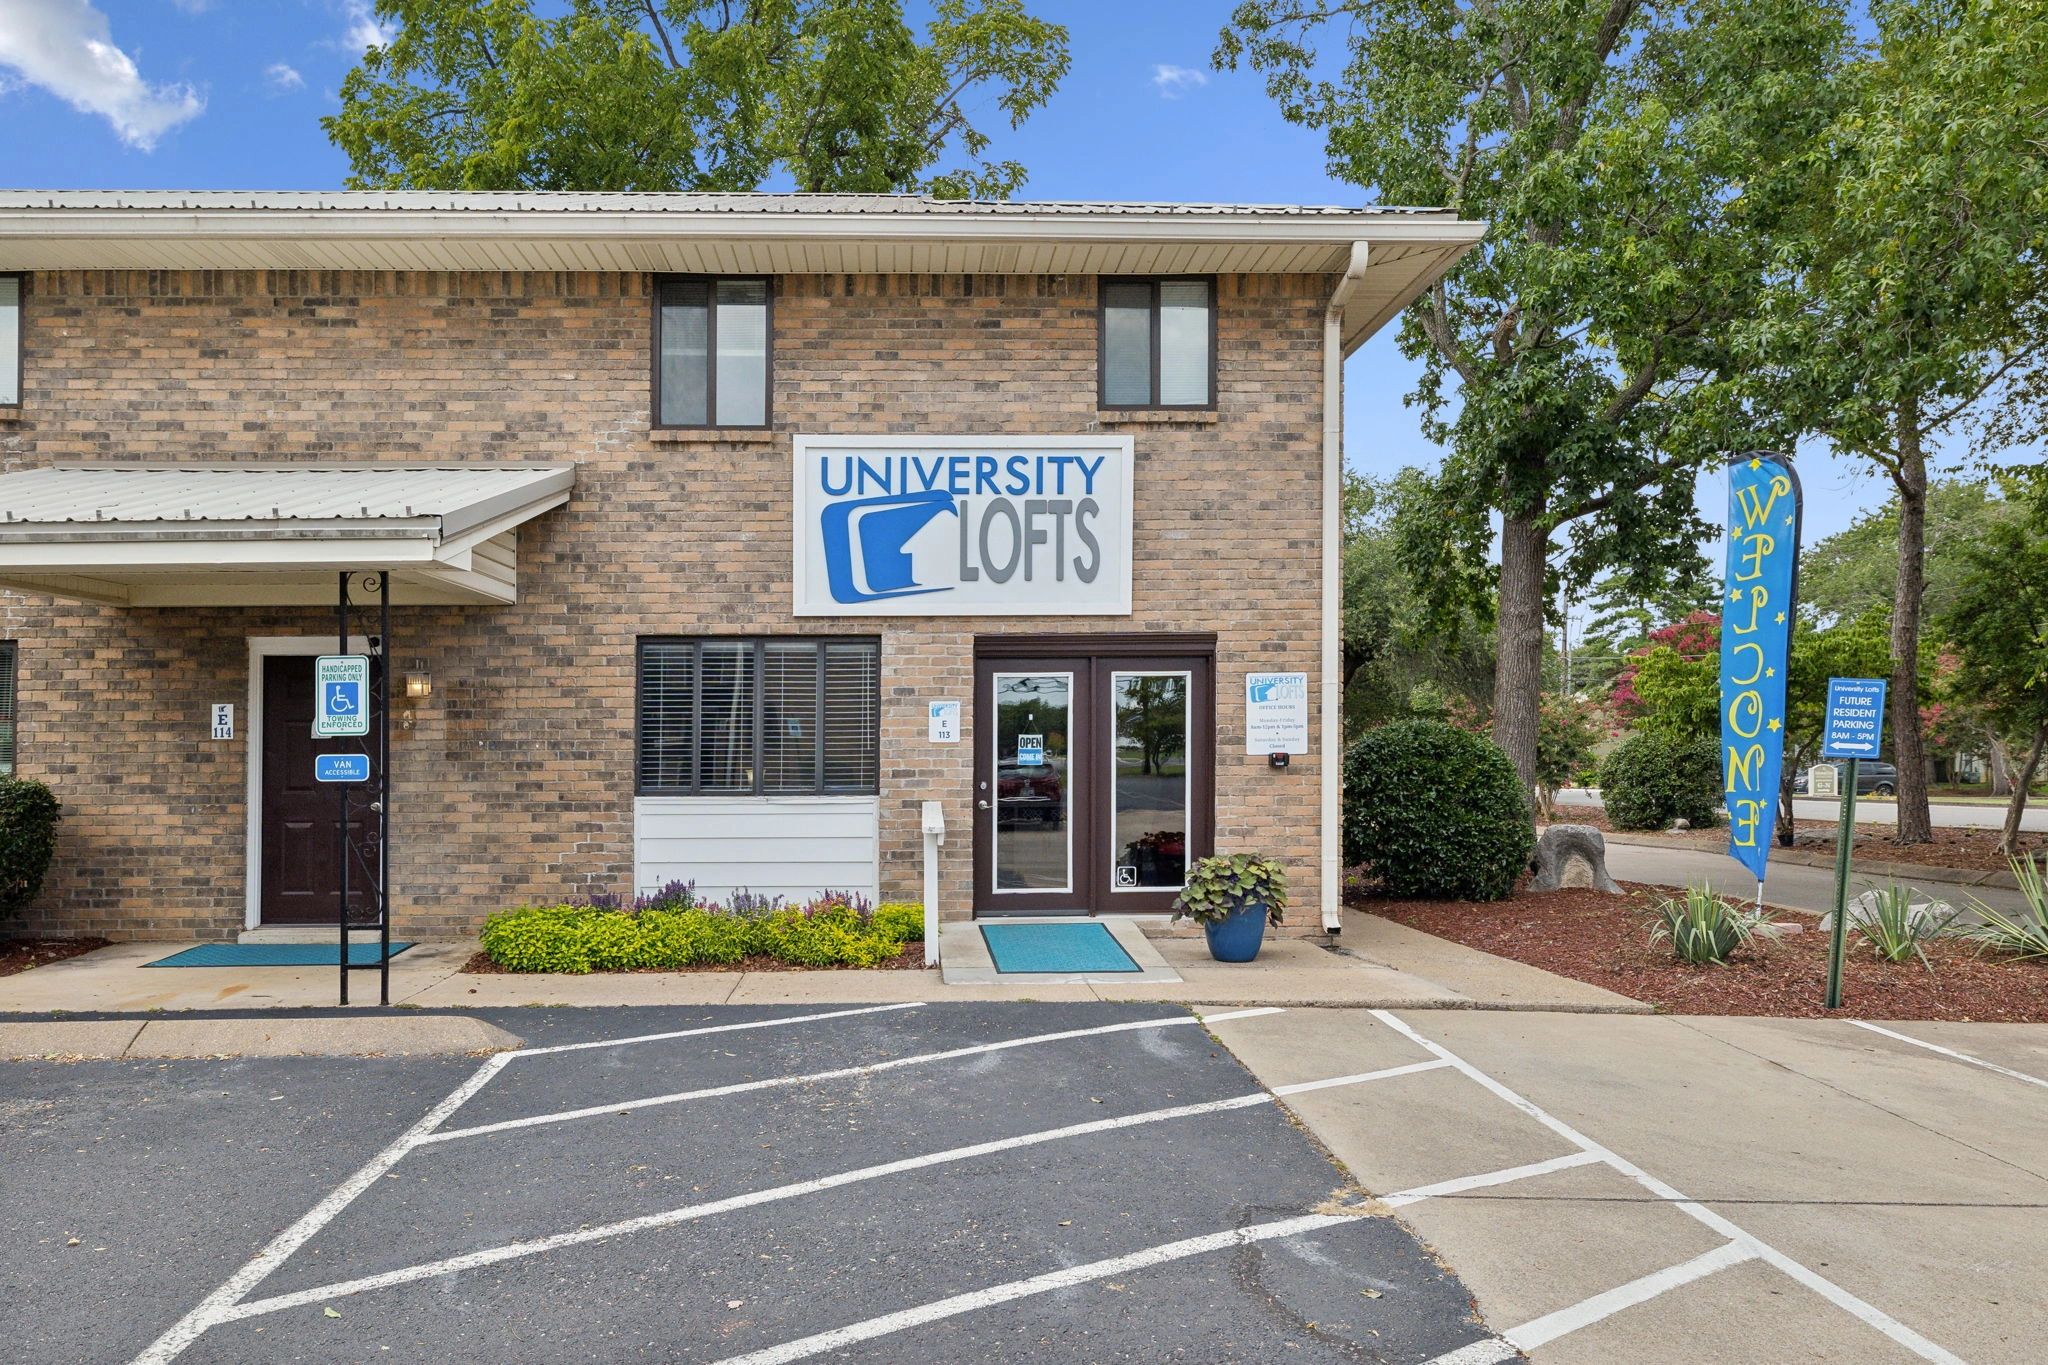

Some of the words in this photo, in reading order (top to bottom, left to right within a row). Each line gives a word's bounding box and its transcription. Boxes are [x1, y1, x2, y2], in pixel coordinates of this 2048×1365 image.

[820, 456, 1105, 496] UNIVERSITY
[959, 497, 1101, 584] LOFTS
[321, 665, 363, 673] HANDICAPPED
[321, 674, 347, 682] PARKING
[347, 674, 363, 682] ONLY
[1249, 676, 1304, 685] UNIVERSITY
[1275, 685, 1305, 700] LOFTS
[1834, 685, 1864, 693] University
[1839, 696, 1873, 706] FUTURE
[1833, 708, 1877, 718] RESIDENT
[217, 714, 228, 726] E
[321, 721, 363, 729] ENFORCED
[942, 720, 948, 728] E
[1832, 719, 1875, 730] PARKING
[213, 727, 232, 738] 114
[938, 731, 951, 739] 113
[1831, 731, 1850, 739] 8AM
[1857, 732, 1875, 741] 5PM
[1019, 736, 1042, 749] OPEN
[1020, 753, 1036, 761] COME
[333, 760, 352, 769] VAN
